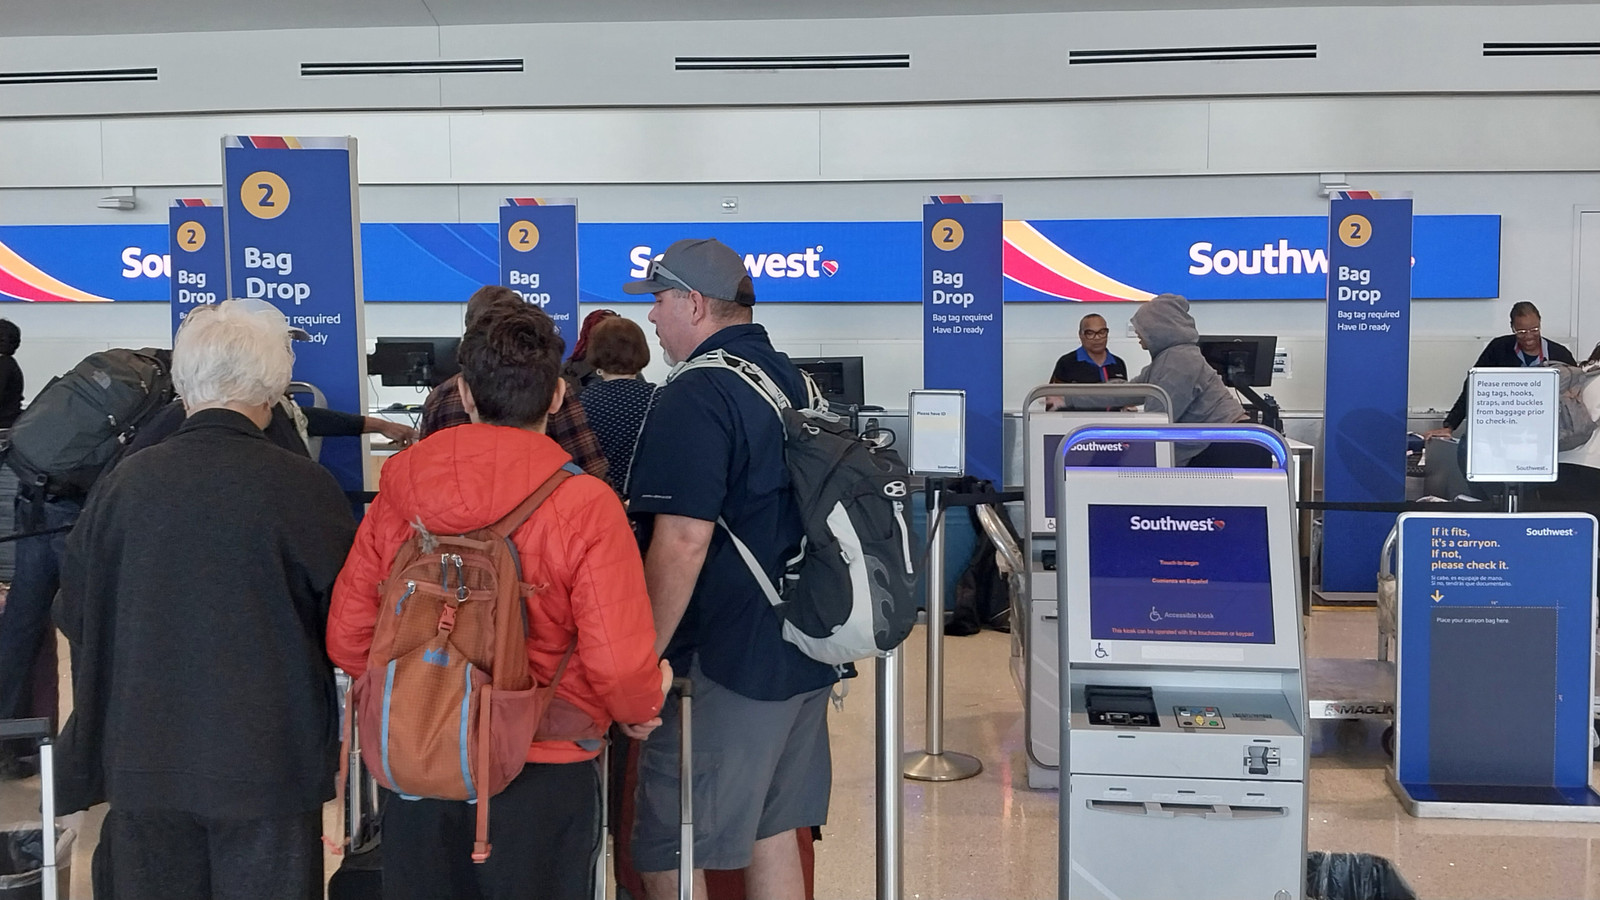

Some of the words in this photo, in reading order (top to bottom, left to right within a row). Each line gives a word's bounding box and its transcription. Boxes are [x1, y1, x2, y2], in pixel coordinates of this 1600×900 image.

[258, 184, 275, 207] 2
[187, 229, 197, 244] 2
[519, 228, 529, 244] 2
[943, 227, 954, 243] 2
[1350, 223, 1362, 239] 2
[245, 248, 292, 275] Bag
[630, 246, 820, 278] Swest
[1189, 239, 1328, 275] Southw
[178, 270, 206, 288] Bag
[510, 270, 540, 288] Bag
[932, 270, 964, 288] Bag
[1338, 266, 1370, 285] Bag
[178, 289, 216, 305] Drop
[246, 277, 311, 305] Drop
[512, 290, 550, 308] rop
[932, 290, 974, 308] Drop
[1338, 286, 1382, 306] Drop
[293, 313, 341, 326] required
[932, 314, 946, 323] Bag
[948, 315, 960, 323] tag
[962, 314, 993, 323] required
[1338, 310, 1353, 320] Bag
[1354, 311, 1366, 320] tag
[1368, 310, 1400, 320] required
[963, 326, 984, 335] ready
[1338, 323, 1357, 331] Have
[1358, 323, 1368, 331] ID
[1369, 322, 1391, 332] ready
[307, 332, 328, 346] ady
[1130, 516, 1214, 531] Southwest
[1432, 528, 1440, 536] If
[1442, 528, 1448, 536] it
[1451, 528, 1470, 537] fits,
[1526, 528, 1573, 536] Southwest
[1457, 541, 1500, 550] carryon.
[1432, 550, 1440, 558] If
[1442, 550, 1462, 560] not,
[1432, 560, 1464, 571] please
[1466, 560, 1496, 570] check
[1499, 560, 1508, 570] it.
